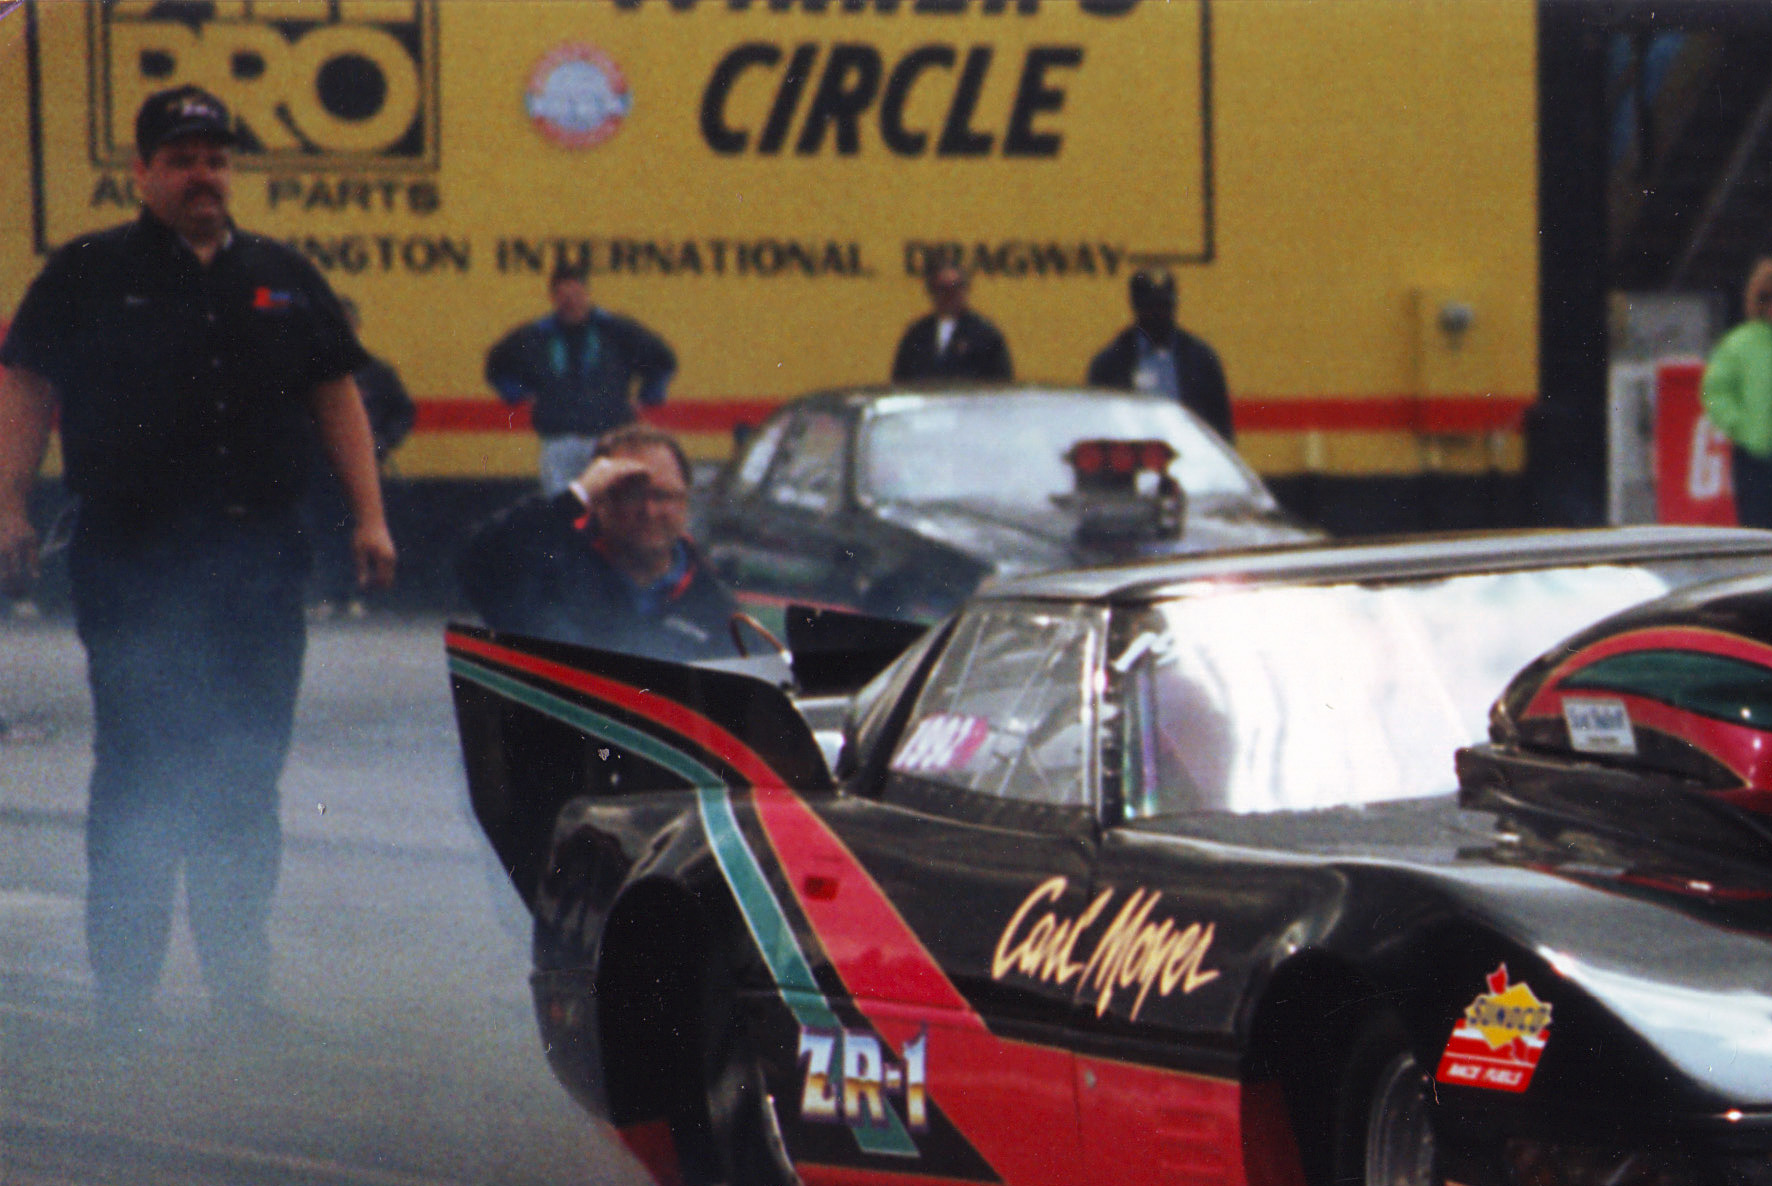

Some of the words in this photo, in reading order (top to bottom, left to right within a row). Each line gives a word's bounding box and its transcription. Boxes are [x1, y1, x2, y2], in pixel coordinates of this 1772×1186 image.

[112, 22, 420, 154] PRO
[700, 41, 1084, 159] CIRCLE
[266, 178, 440, 216] PARTS
[495, 236, 876, 277] INTERNATIONAL
[1465, 995, 1550, 1034] SUNOCO
[798, 1026, 929, 1128] ZR-1
